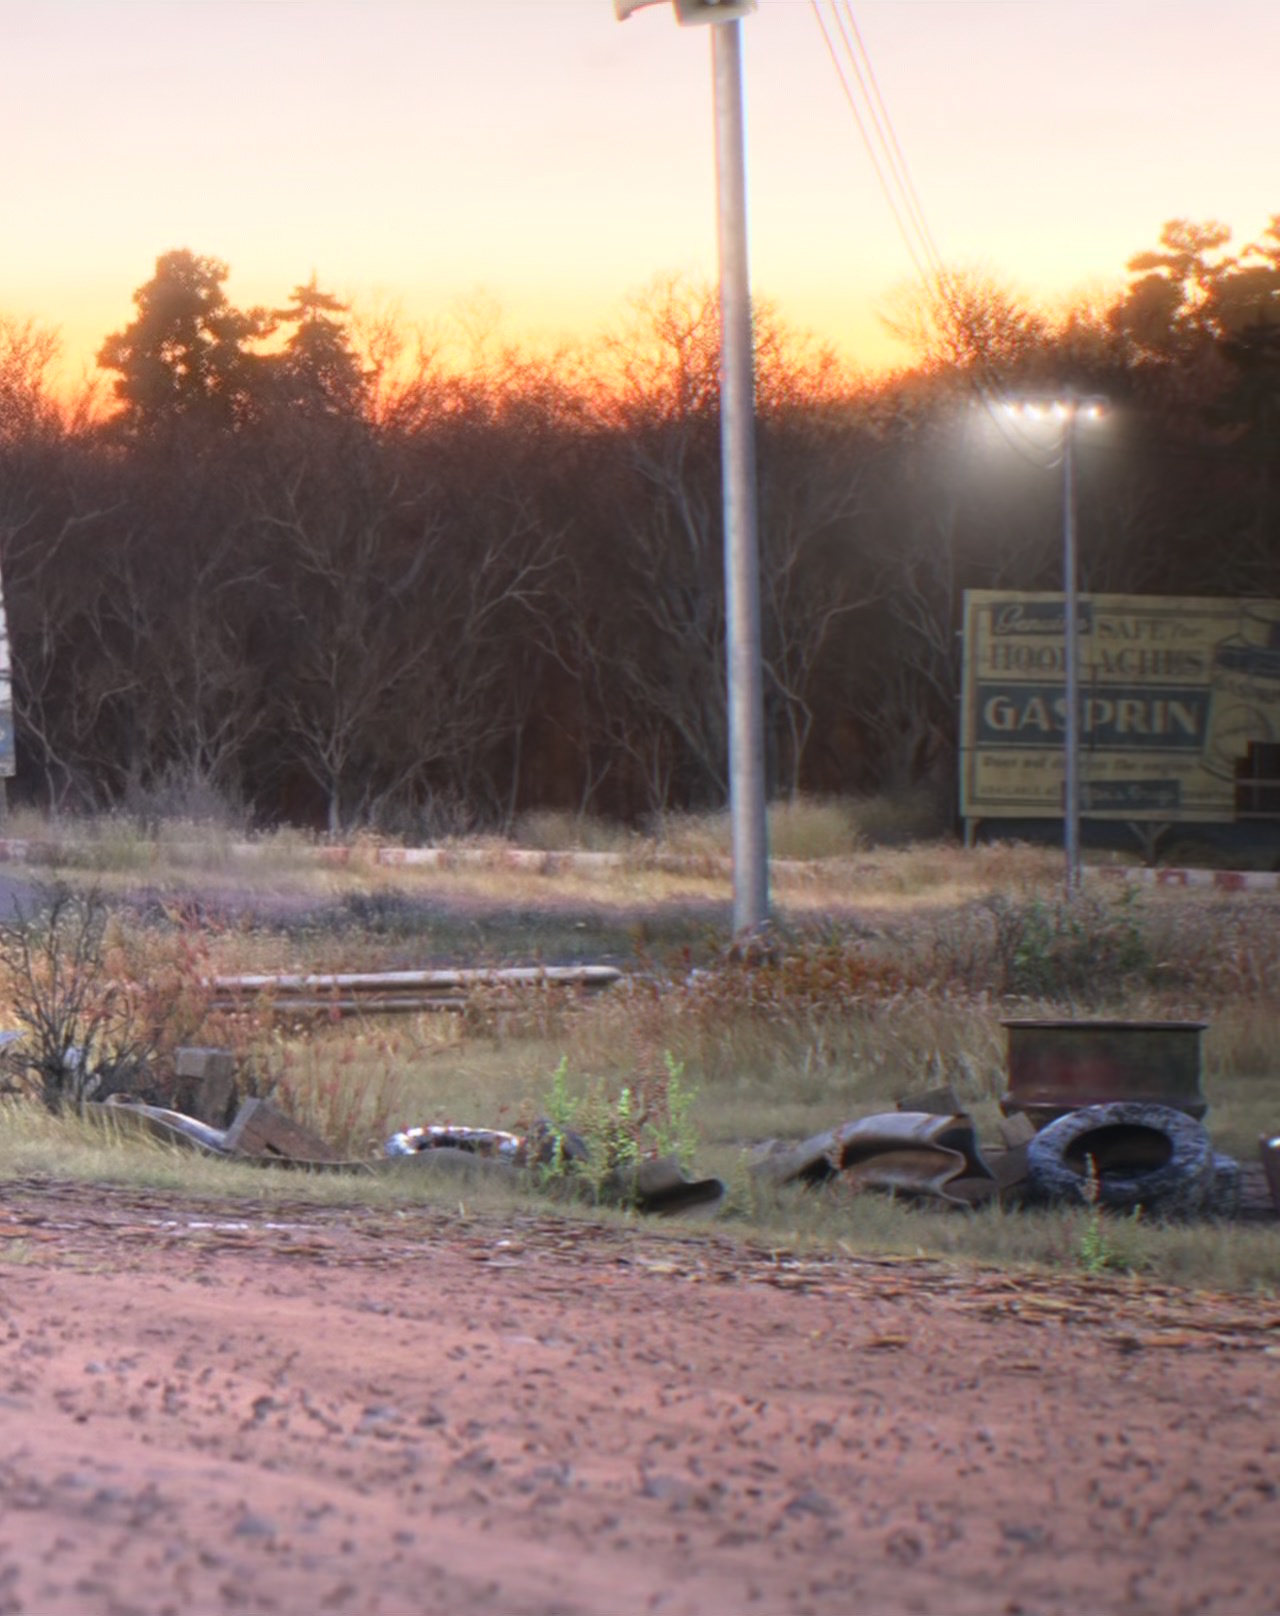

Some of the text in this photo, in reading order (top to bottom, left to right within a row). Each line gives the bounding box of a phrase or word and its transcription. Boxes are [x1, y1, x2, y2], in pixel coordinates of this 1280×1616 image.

[995, 605, 1088, 633] Genuie
[1098, 618, 1167, 641] SAFE
[985, 696, 1199, 733] GASPRIN
